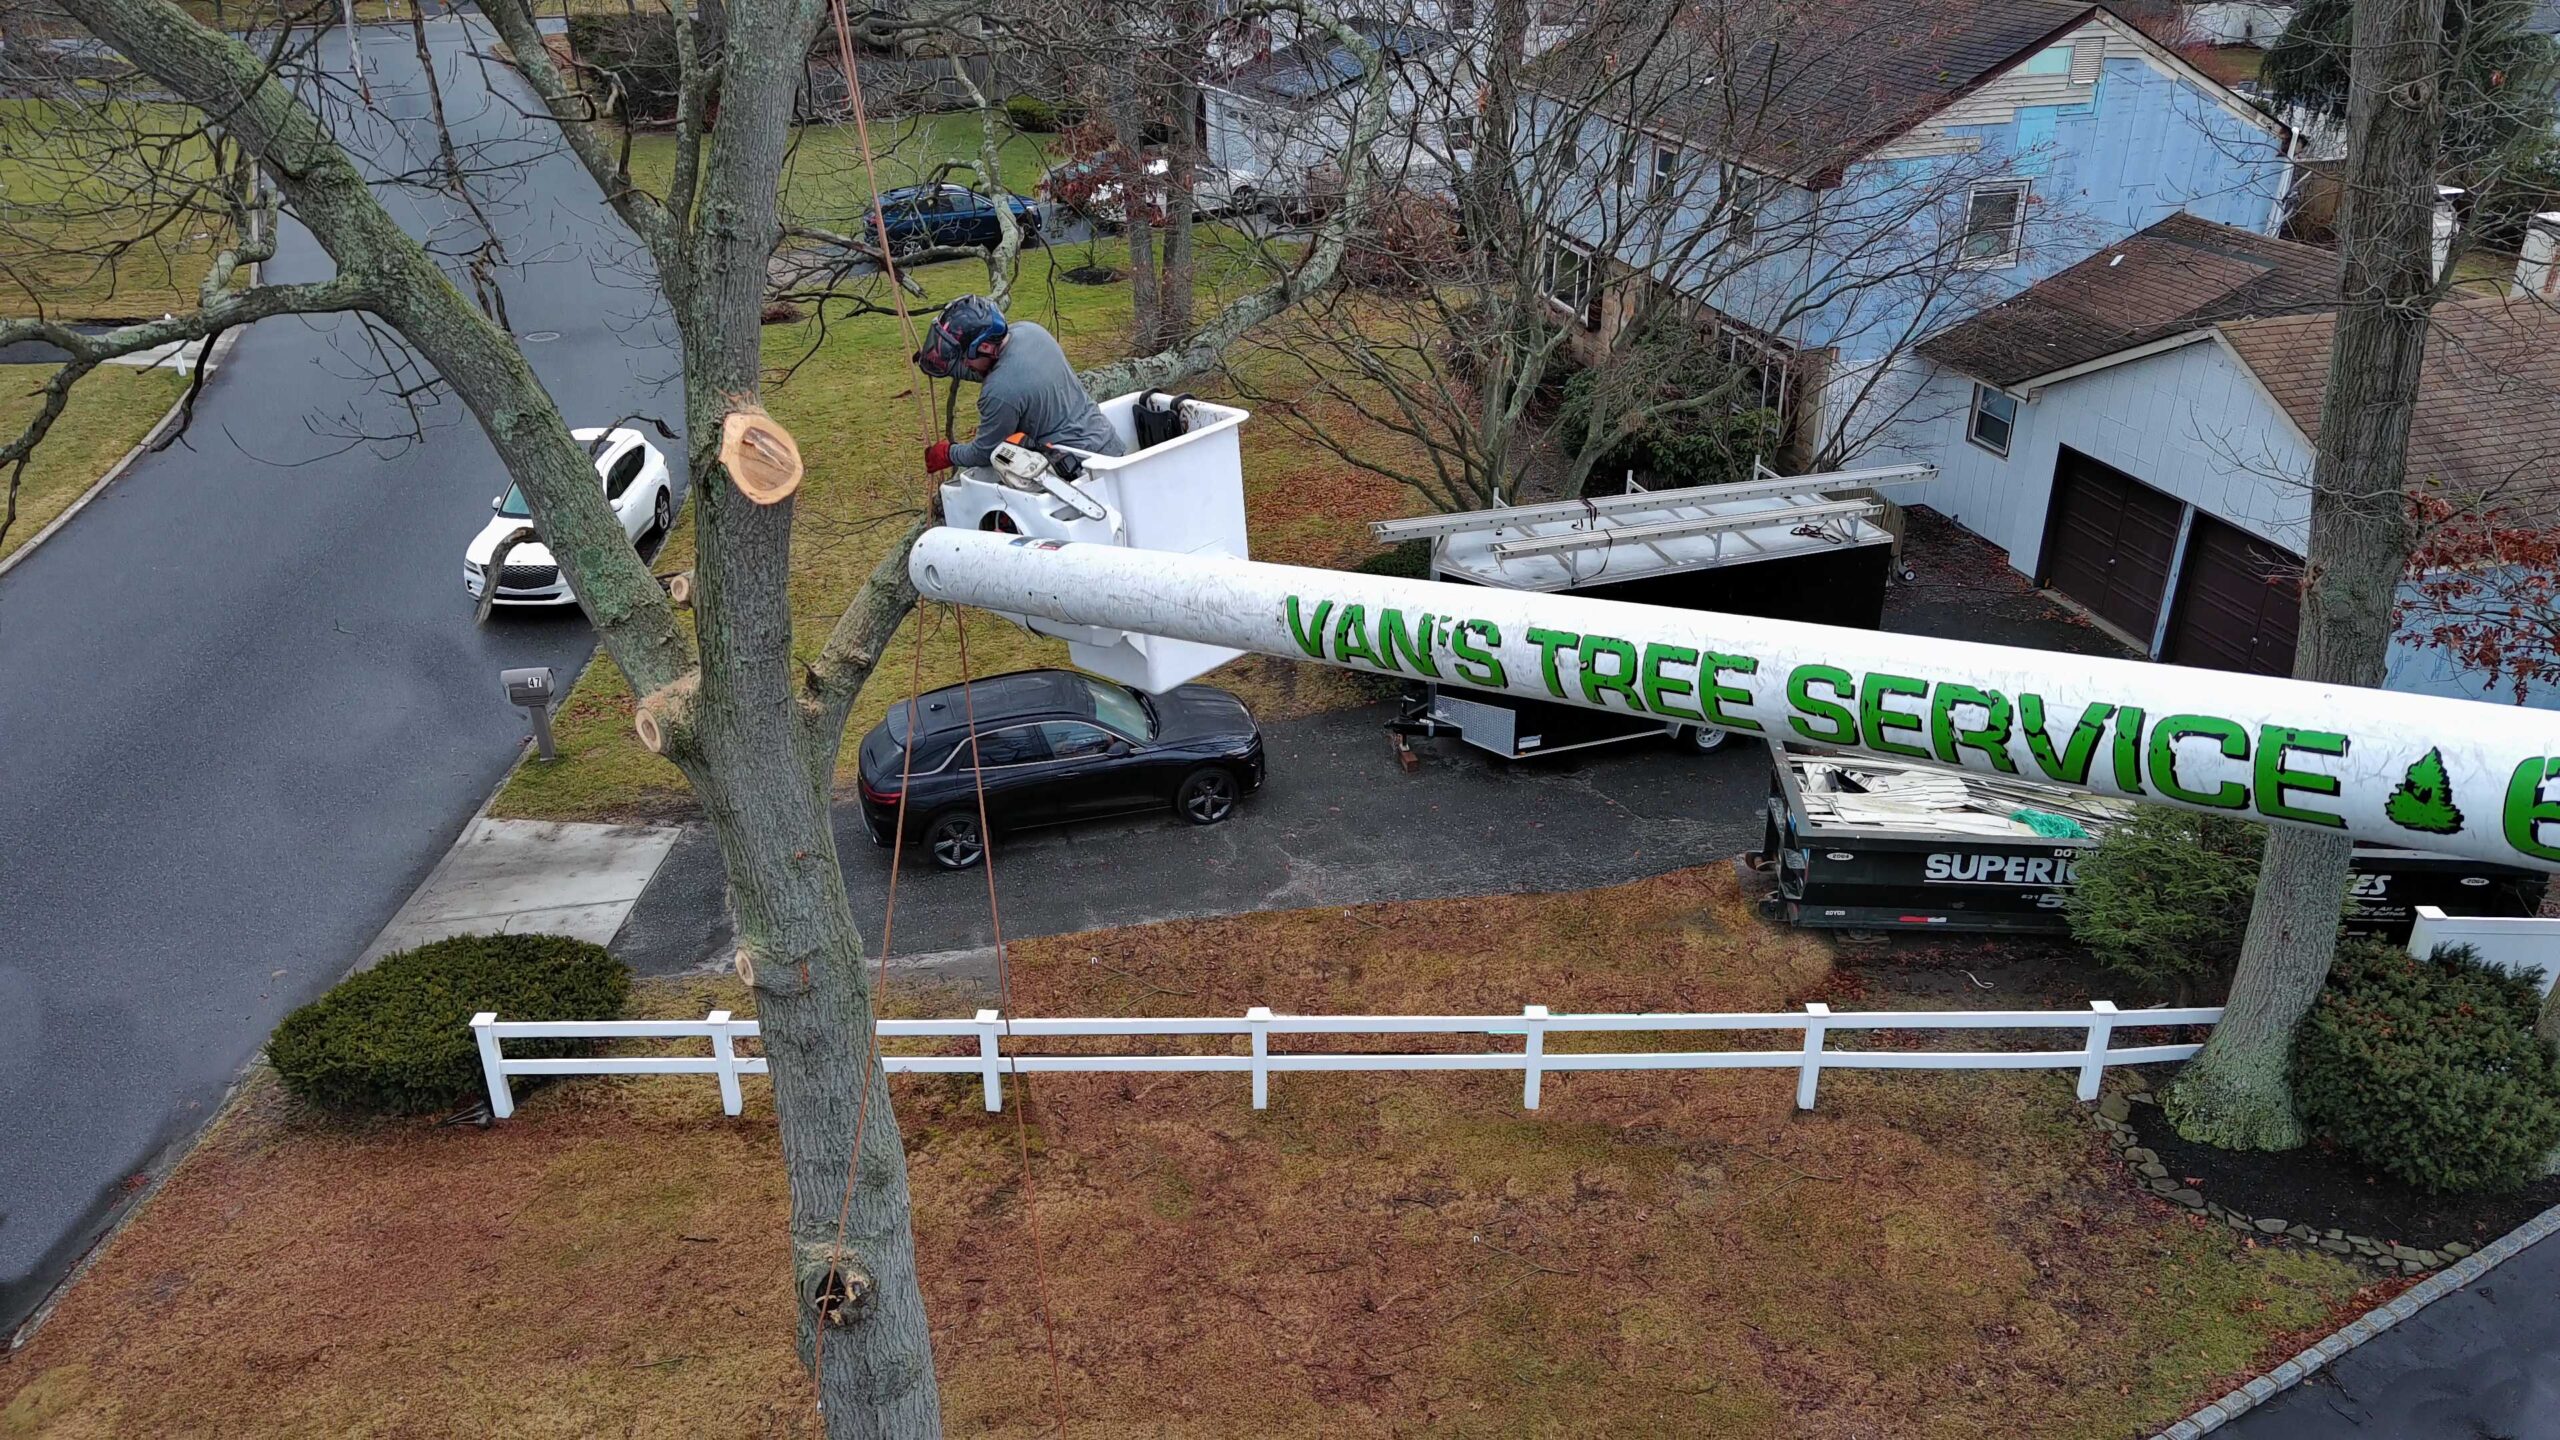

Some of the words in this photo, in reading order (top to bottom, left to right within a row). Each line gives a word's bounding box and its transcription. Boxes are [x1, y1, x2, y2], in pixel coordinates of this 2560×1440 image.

[529, 677, 541, 688] 47
[1286, 594, 1509, 689] VAN'S
[1526, 626, 1765, 732] TREE
[1786, 663, 2350, 828] SERVICE
[2053, 848, 2072, 858] DO
